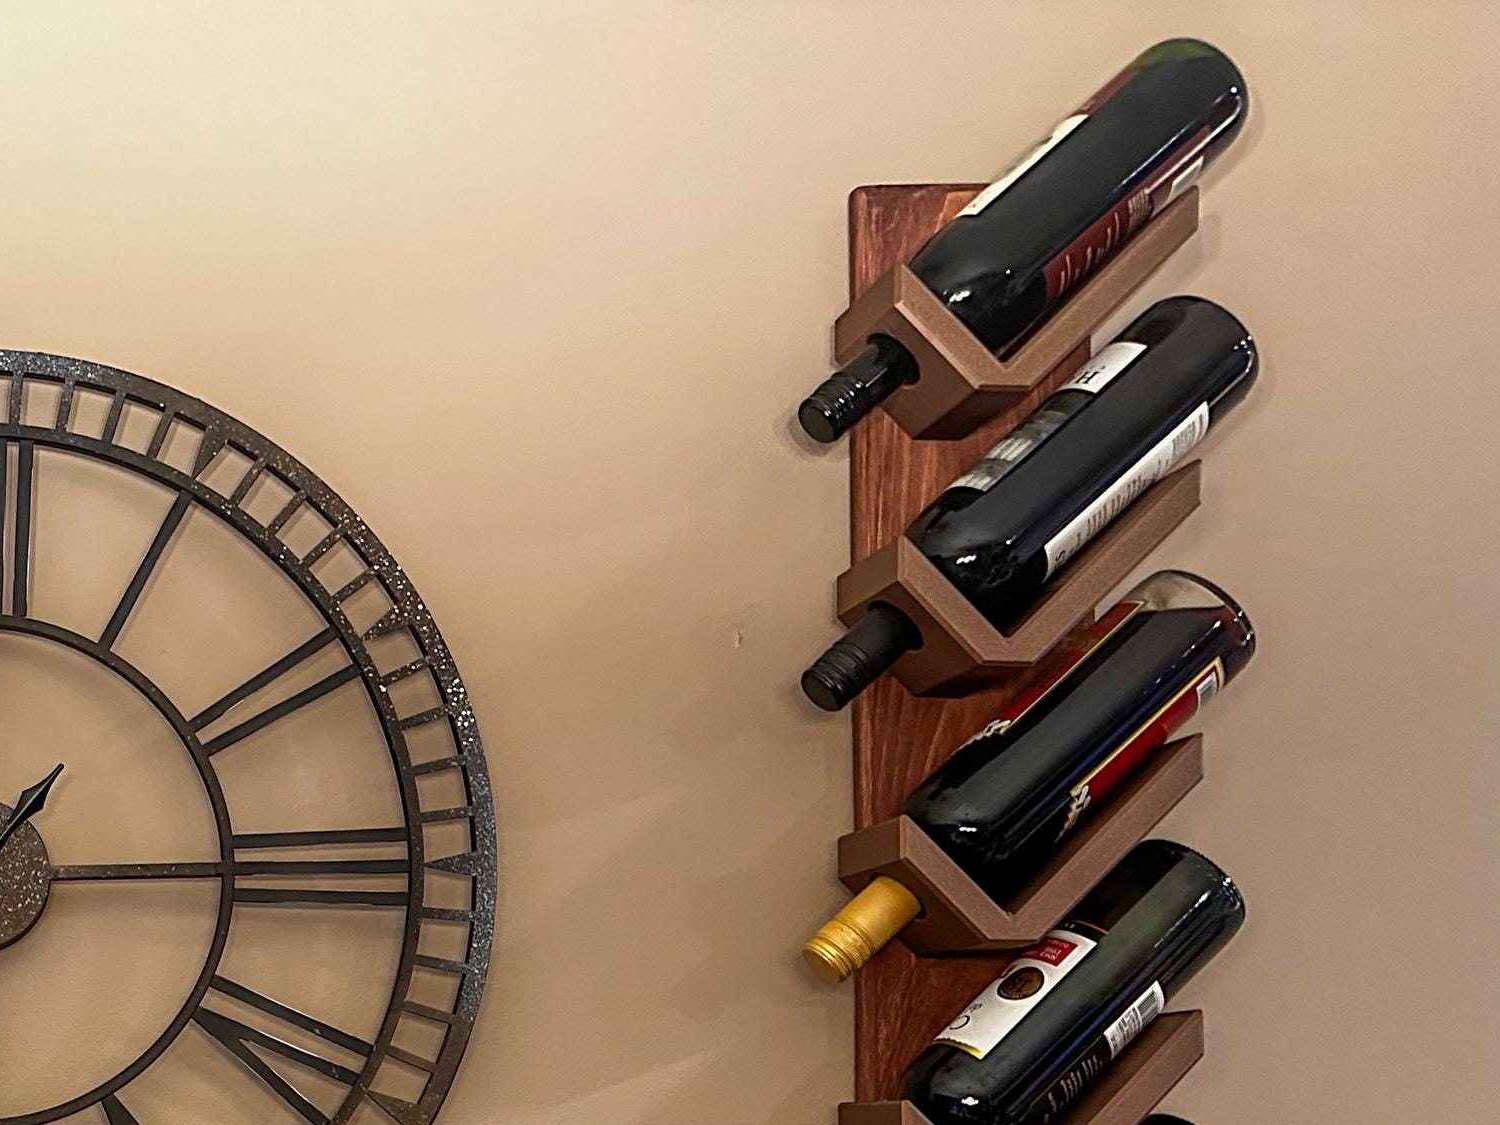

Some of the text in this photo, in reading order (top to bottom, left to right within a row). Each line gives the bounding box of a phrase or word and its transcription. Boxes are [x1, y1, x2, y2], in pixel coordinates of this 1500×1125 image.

[102, 489, 191, 651] I
[192, 628, 362, 754] II
[232, 828, 410, 904] III
